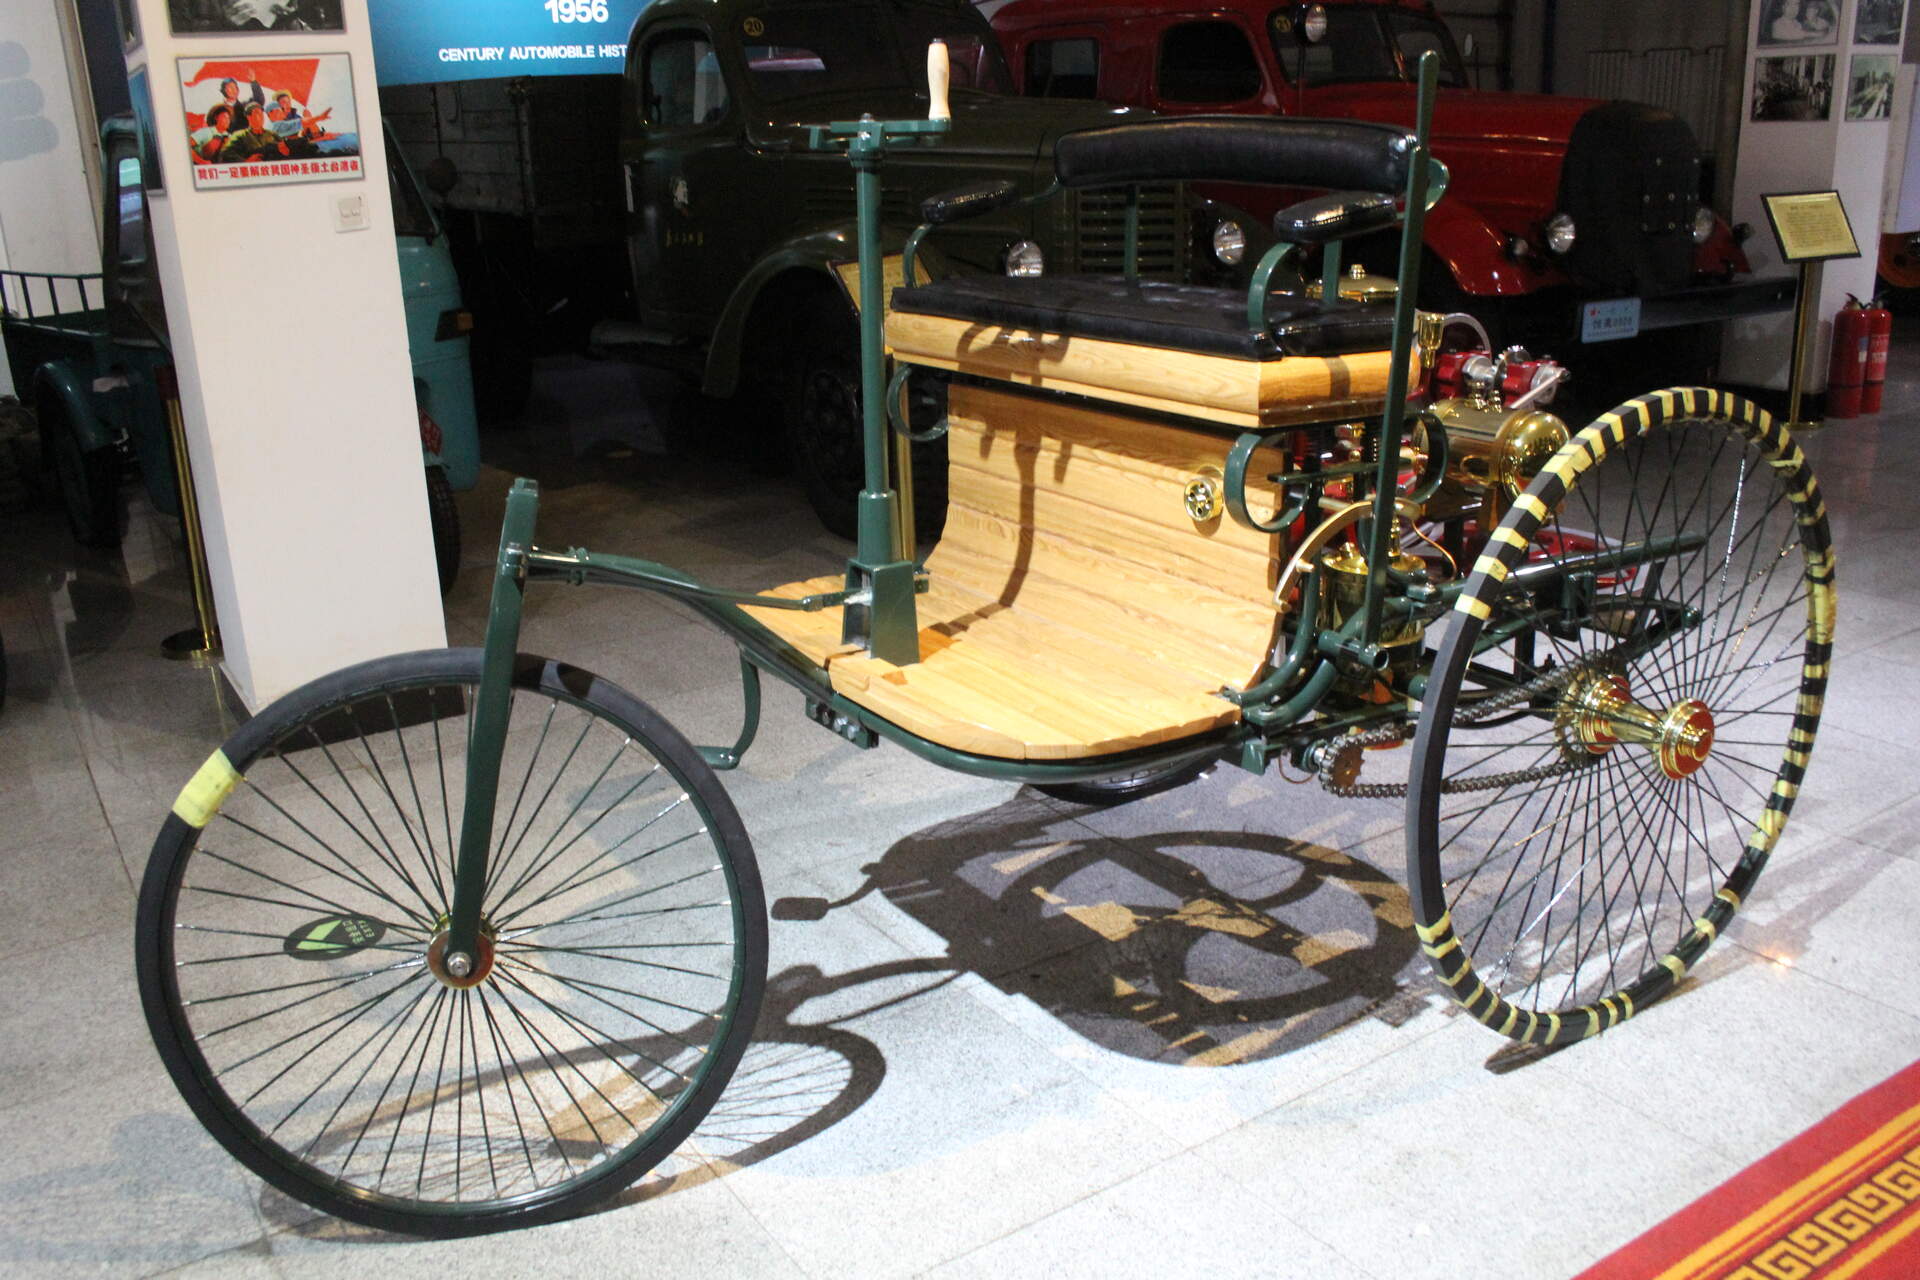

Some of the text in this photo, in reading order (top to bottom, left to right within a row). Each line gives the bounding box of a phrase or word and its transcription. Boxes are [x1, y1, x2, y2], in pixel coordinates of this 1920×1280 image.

[545, 0, 609, 23] 1956
[438, 47, 504, 62] CENTURY
[509, 45, 595, 60] AUTOMOBILE
